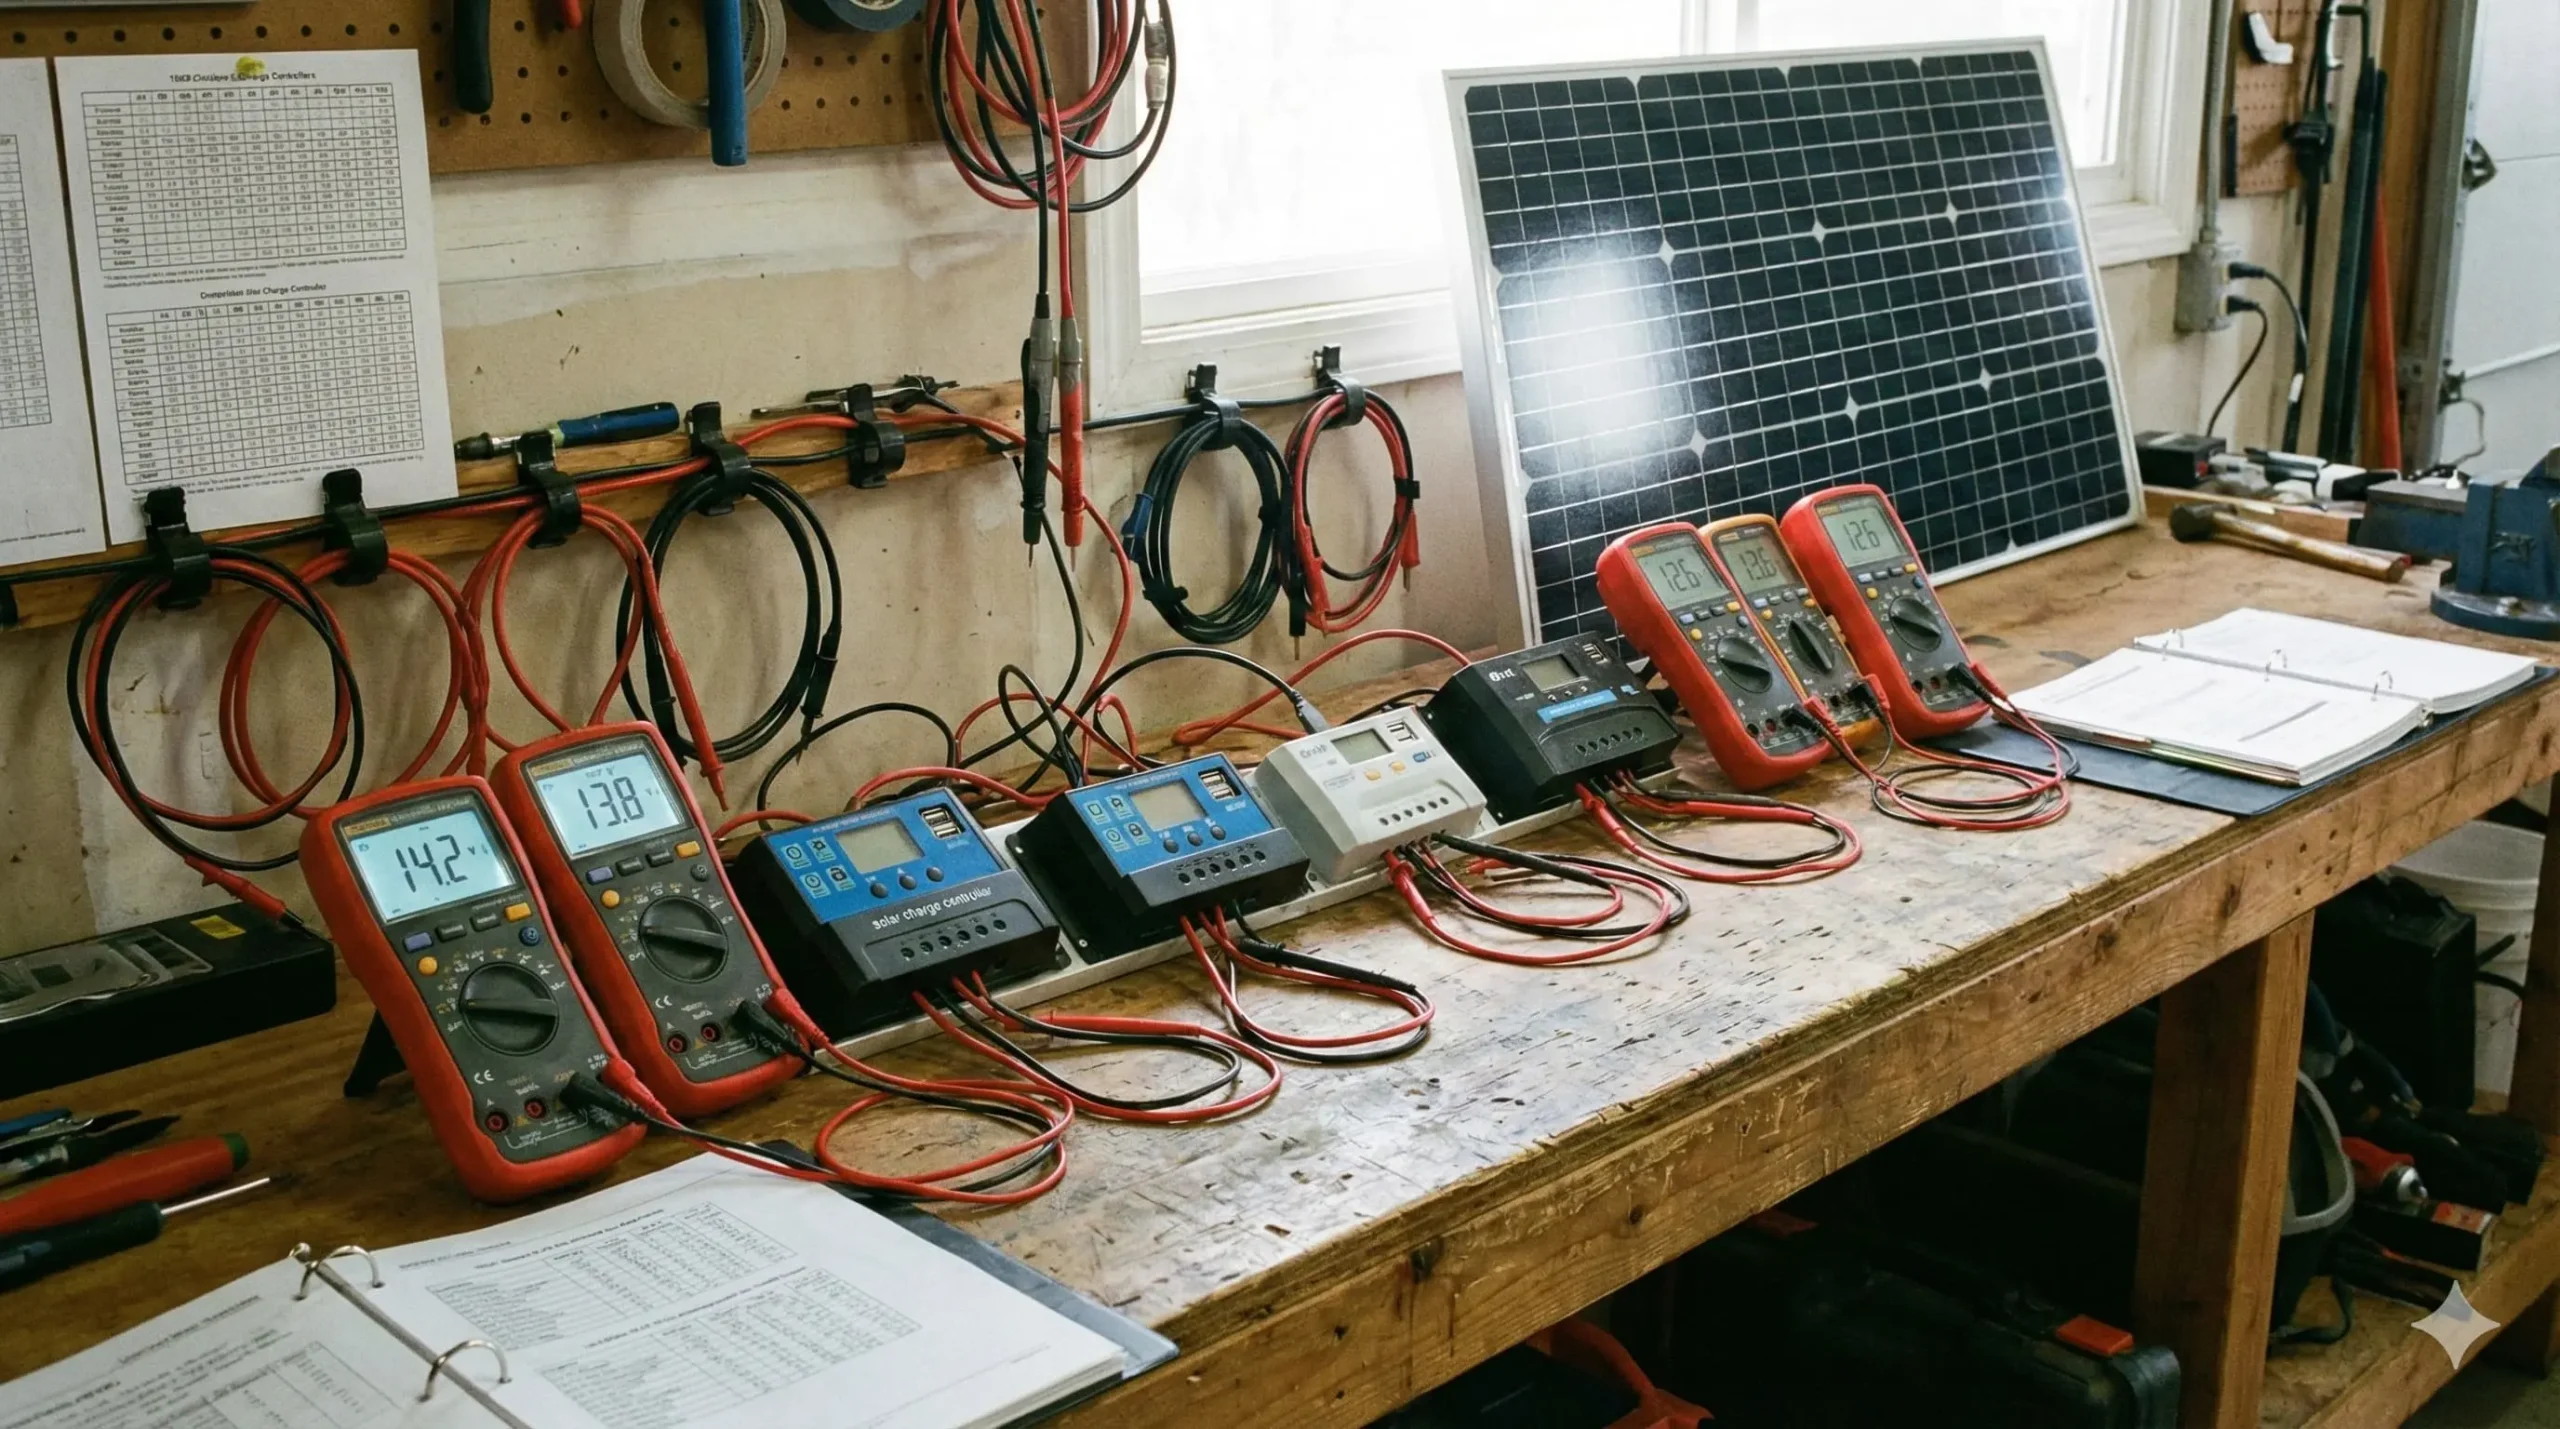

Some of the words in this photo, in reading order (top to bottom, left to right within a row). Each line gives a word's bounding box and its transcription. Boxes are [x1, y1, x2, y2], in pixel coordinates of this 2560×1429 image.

[577, 776, 645, 829] 13.8
[395, 834, 468, 893] 14.2
[872, 914, 900, 930] solar
